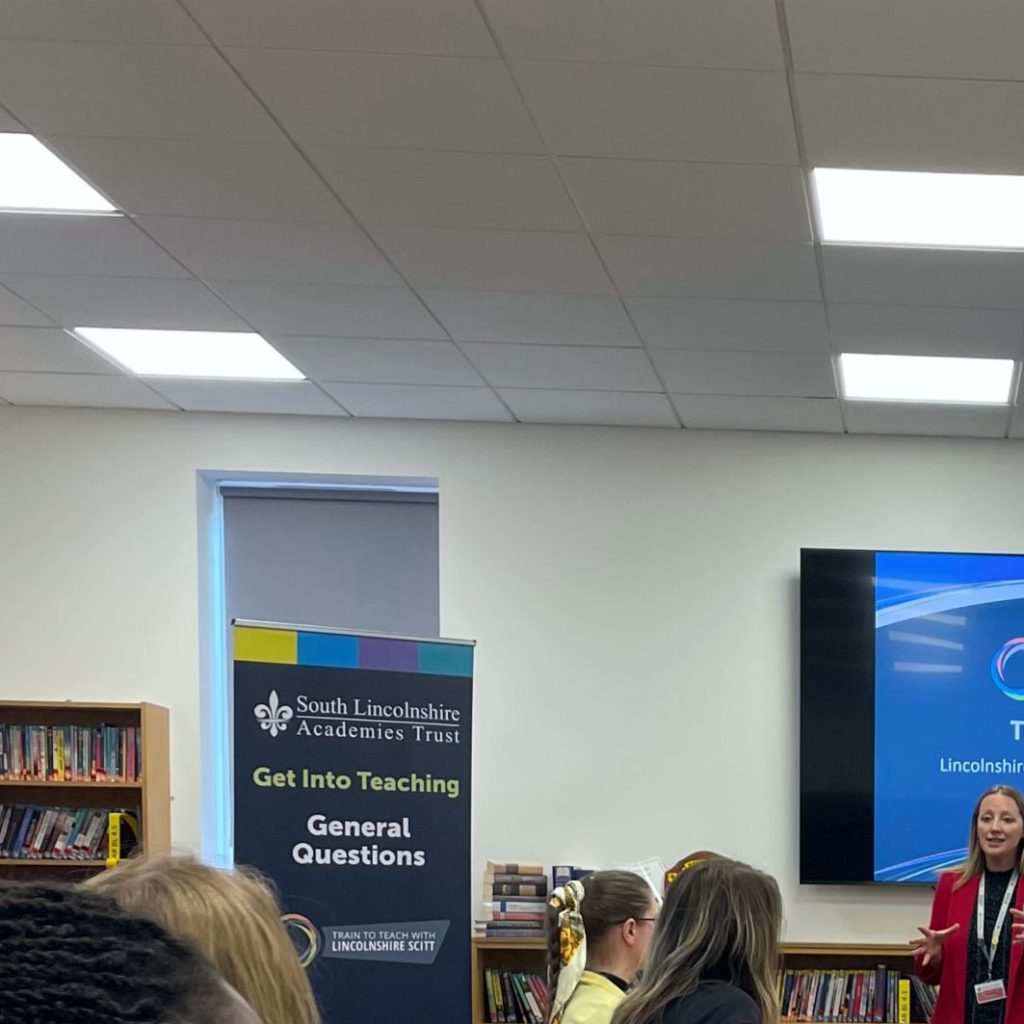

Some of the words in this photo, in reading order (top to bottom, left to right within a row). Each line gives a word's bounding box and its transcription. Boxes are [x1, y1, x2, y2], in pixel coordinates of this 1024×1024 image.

[296, 695, 348, 715] South
[353, 699, 461, 722] Lincolnshire
[296, 719, 405, 741] Academies
[412, 725, 461, 744] Trust
[253, 766, 296, 788] Get
[302, 768, 352, 790] Into
[356, 770, 460, 798] Teaching
[307, 814, 411, 838] General
[292, 843, 426, 867] Questions
[332, 931, 360, 940] TRAIN
[363, 931, 376, 940] TO
[378, 931, 409, 940] TEACH
[411, 931, 436, 940] WITH
[332, 941, 405, 952] LINCOLNSHIRE
[408, 940, 435, 951] SCITT
